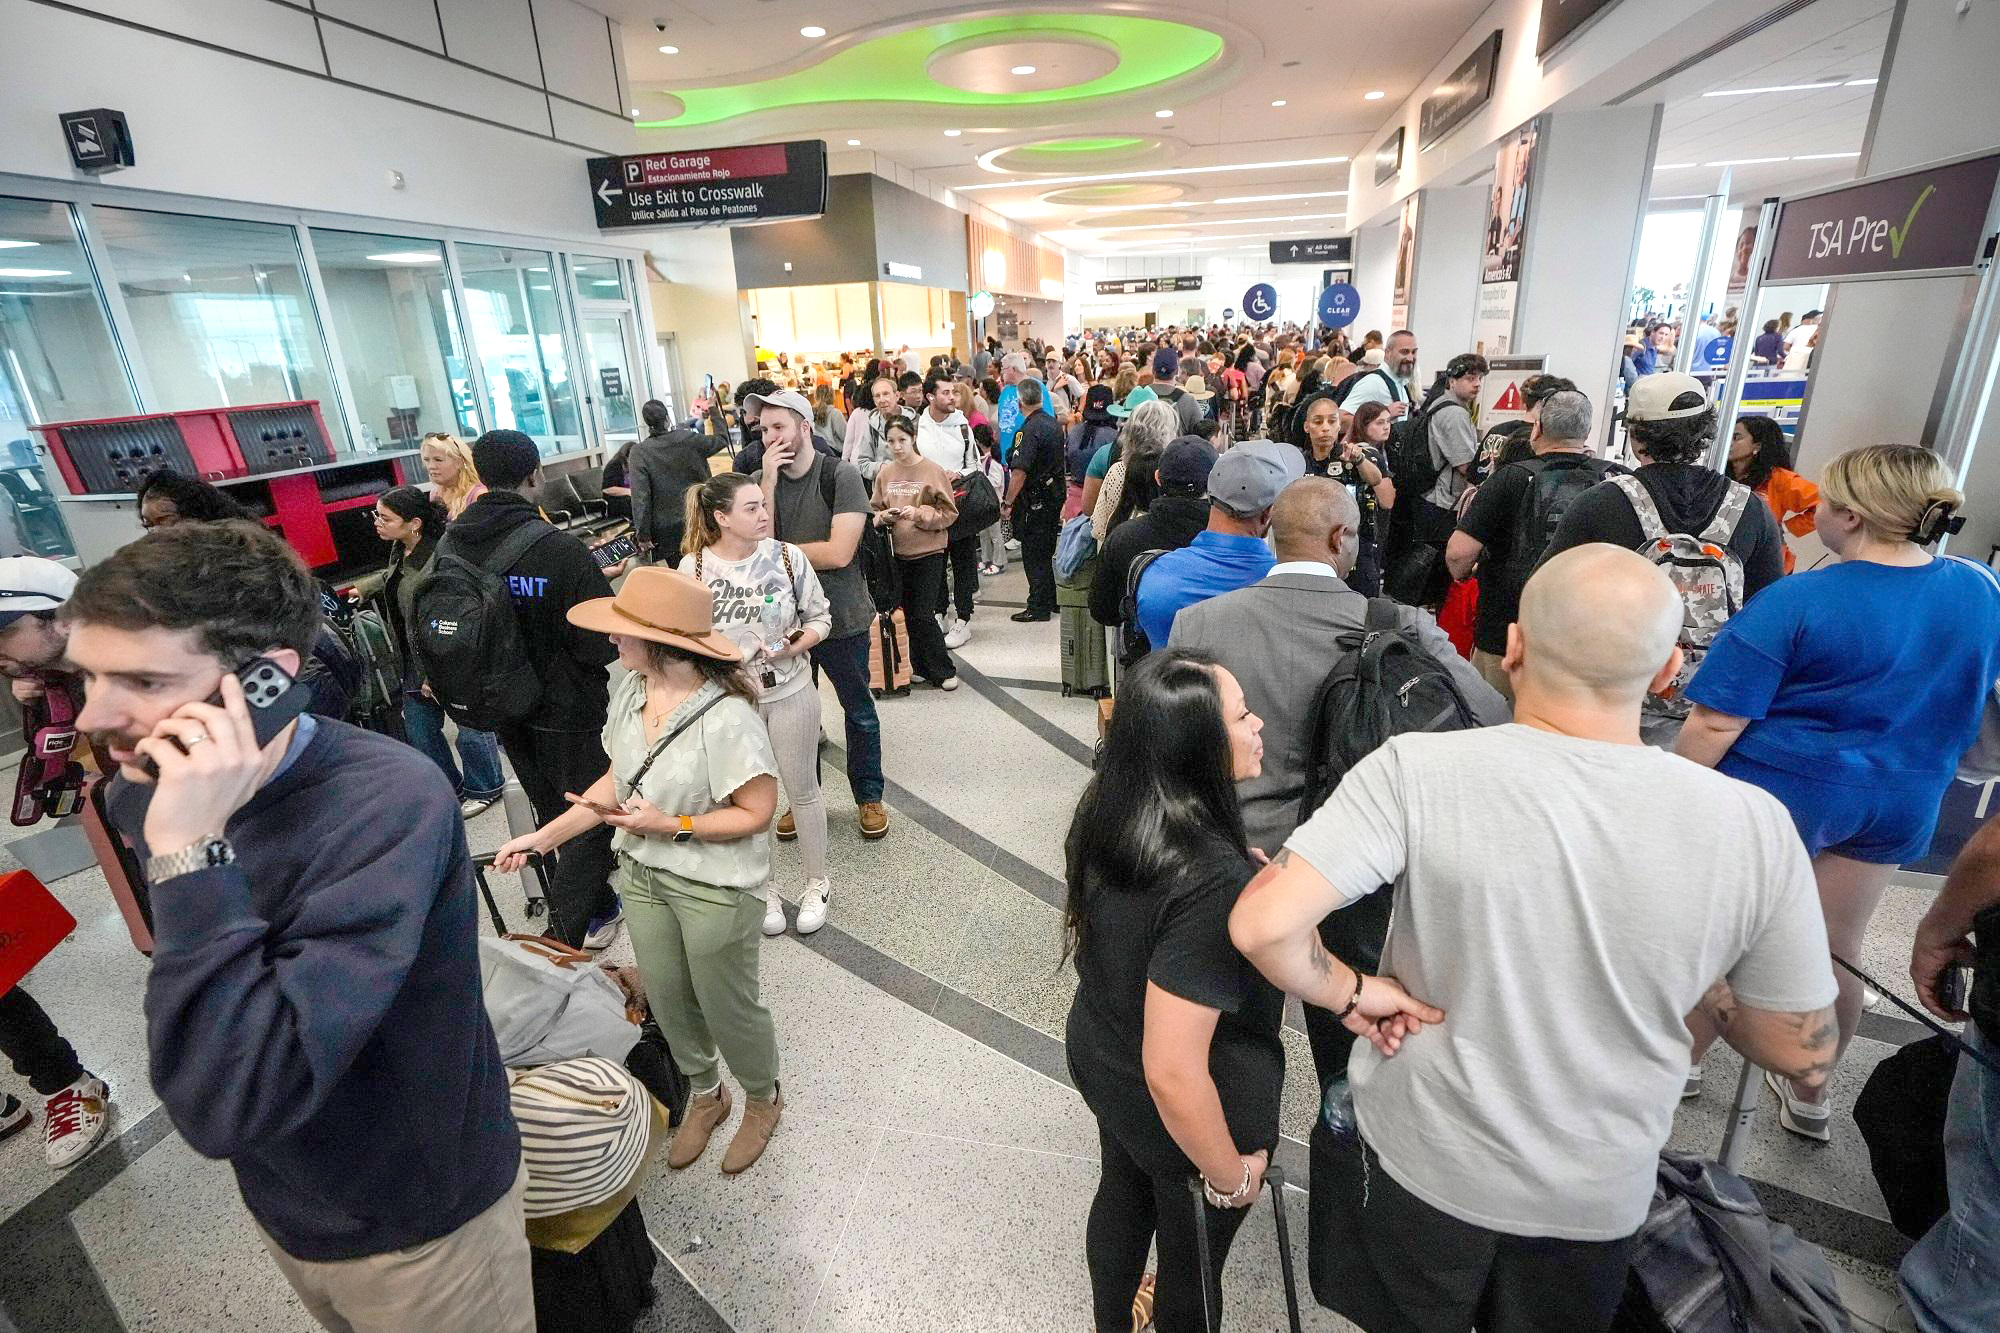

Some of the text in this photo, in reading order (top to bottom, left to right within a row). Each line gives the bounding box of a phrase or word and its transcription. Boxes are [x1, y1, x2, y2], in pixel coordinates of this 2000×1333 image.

[645, 155, 711, 171] Red Garage
[628, 164, 639, 182] P
[648, 169, 730, 184] Estacionamiento Rojo
[629, 183, 764, 206] Use Exit to Crosswalk
[631, 204, 758, 220] Utilice Salida al Paso de Peatones
[1808, 216, 1888, 259] TSA Pre
[1484, 264, 1505, 282] America's
[509, 575, 548, 597] ENT
[708, 579, 782, 600] Choose
